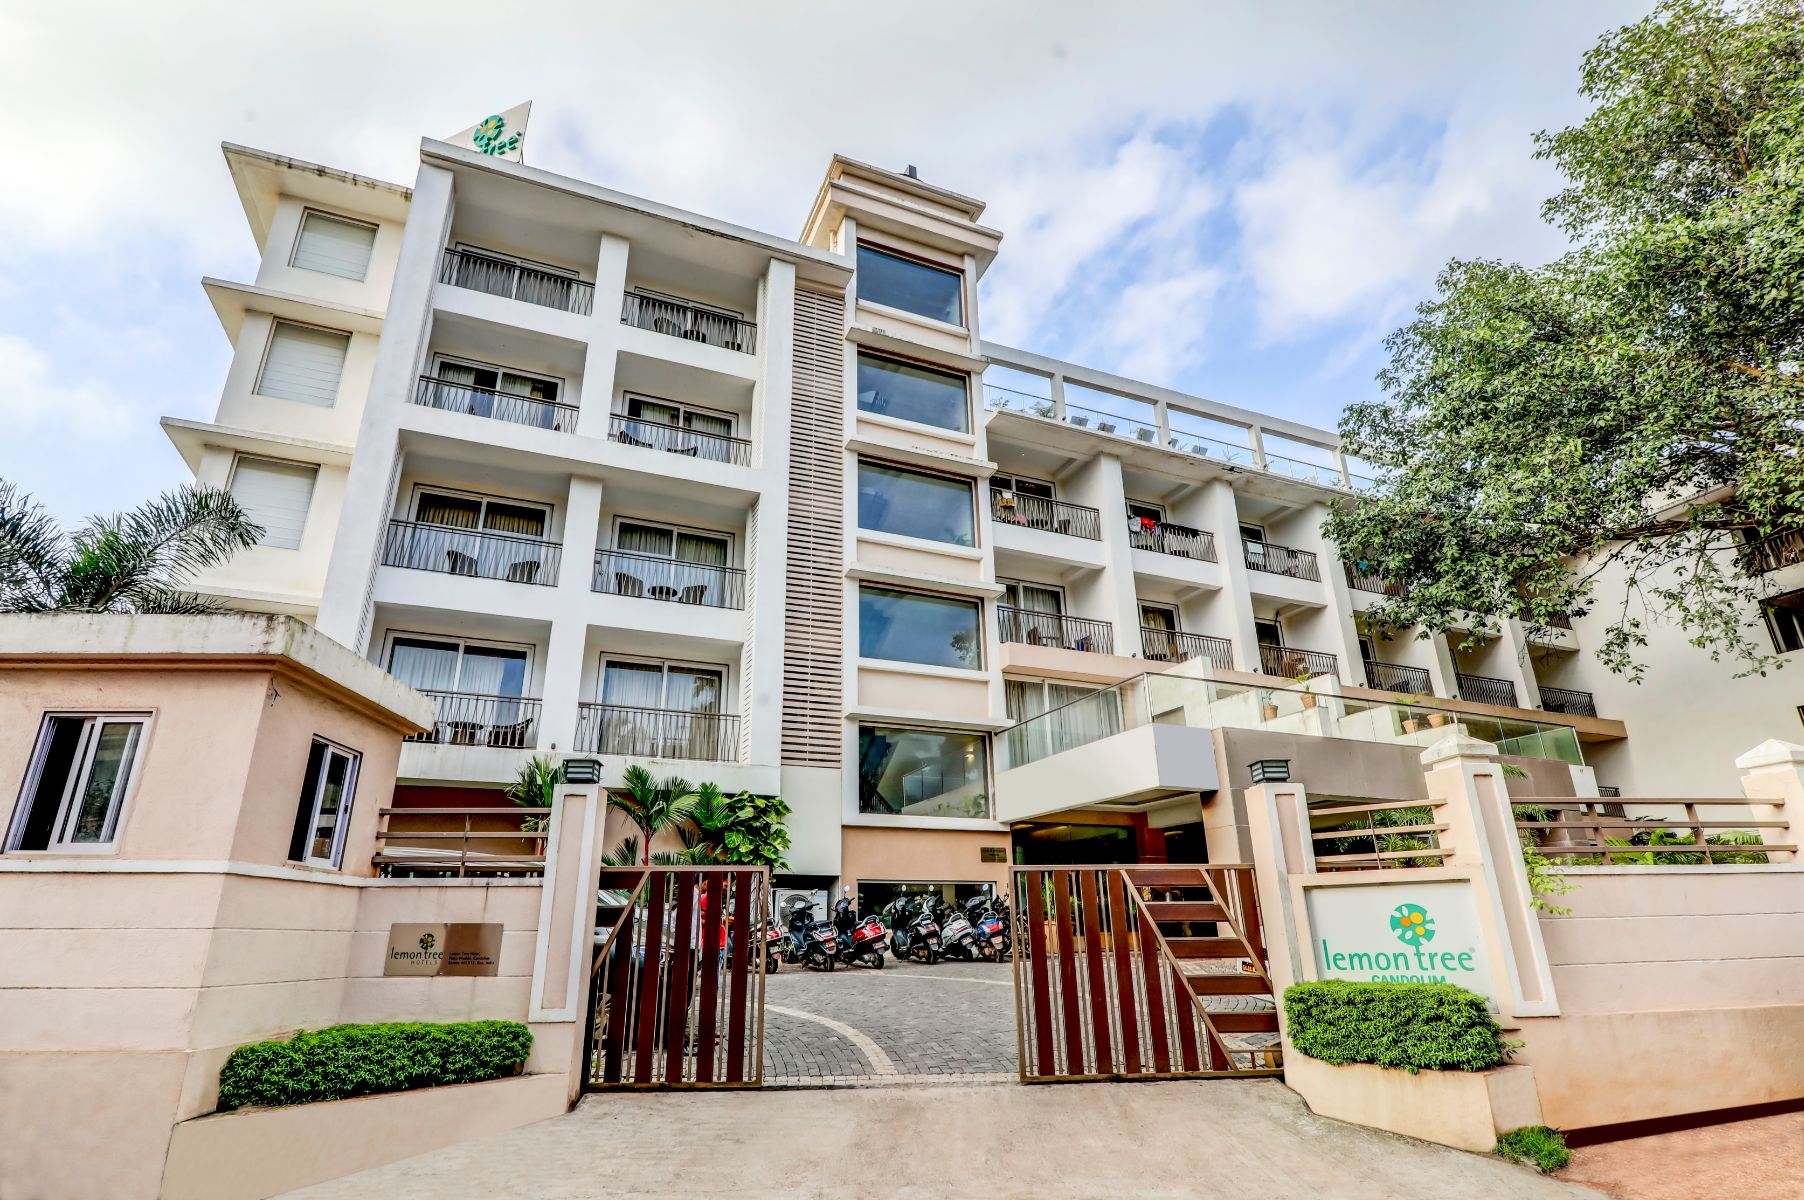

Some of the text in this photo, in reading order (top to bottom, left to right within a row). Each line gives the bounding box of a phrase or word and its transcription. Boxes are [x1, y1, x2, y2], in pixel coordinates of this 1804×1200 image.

[390, 945, 444, 960] lemon tree
[1322, 939, 1475, 971] lemon tree
